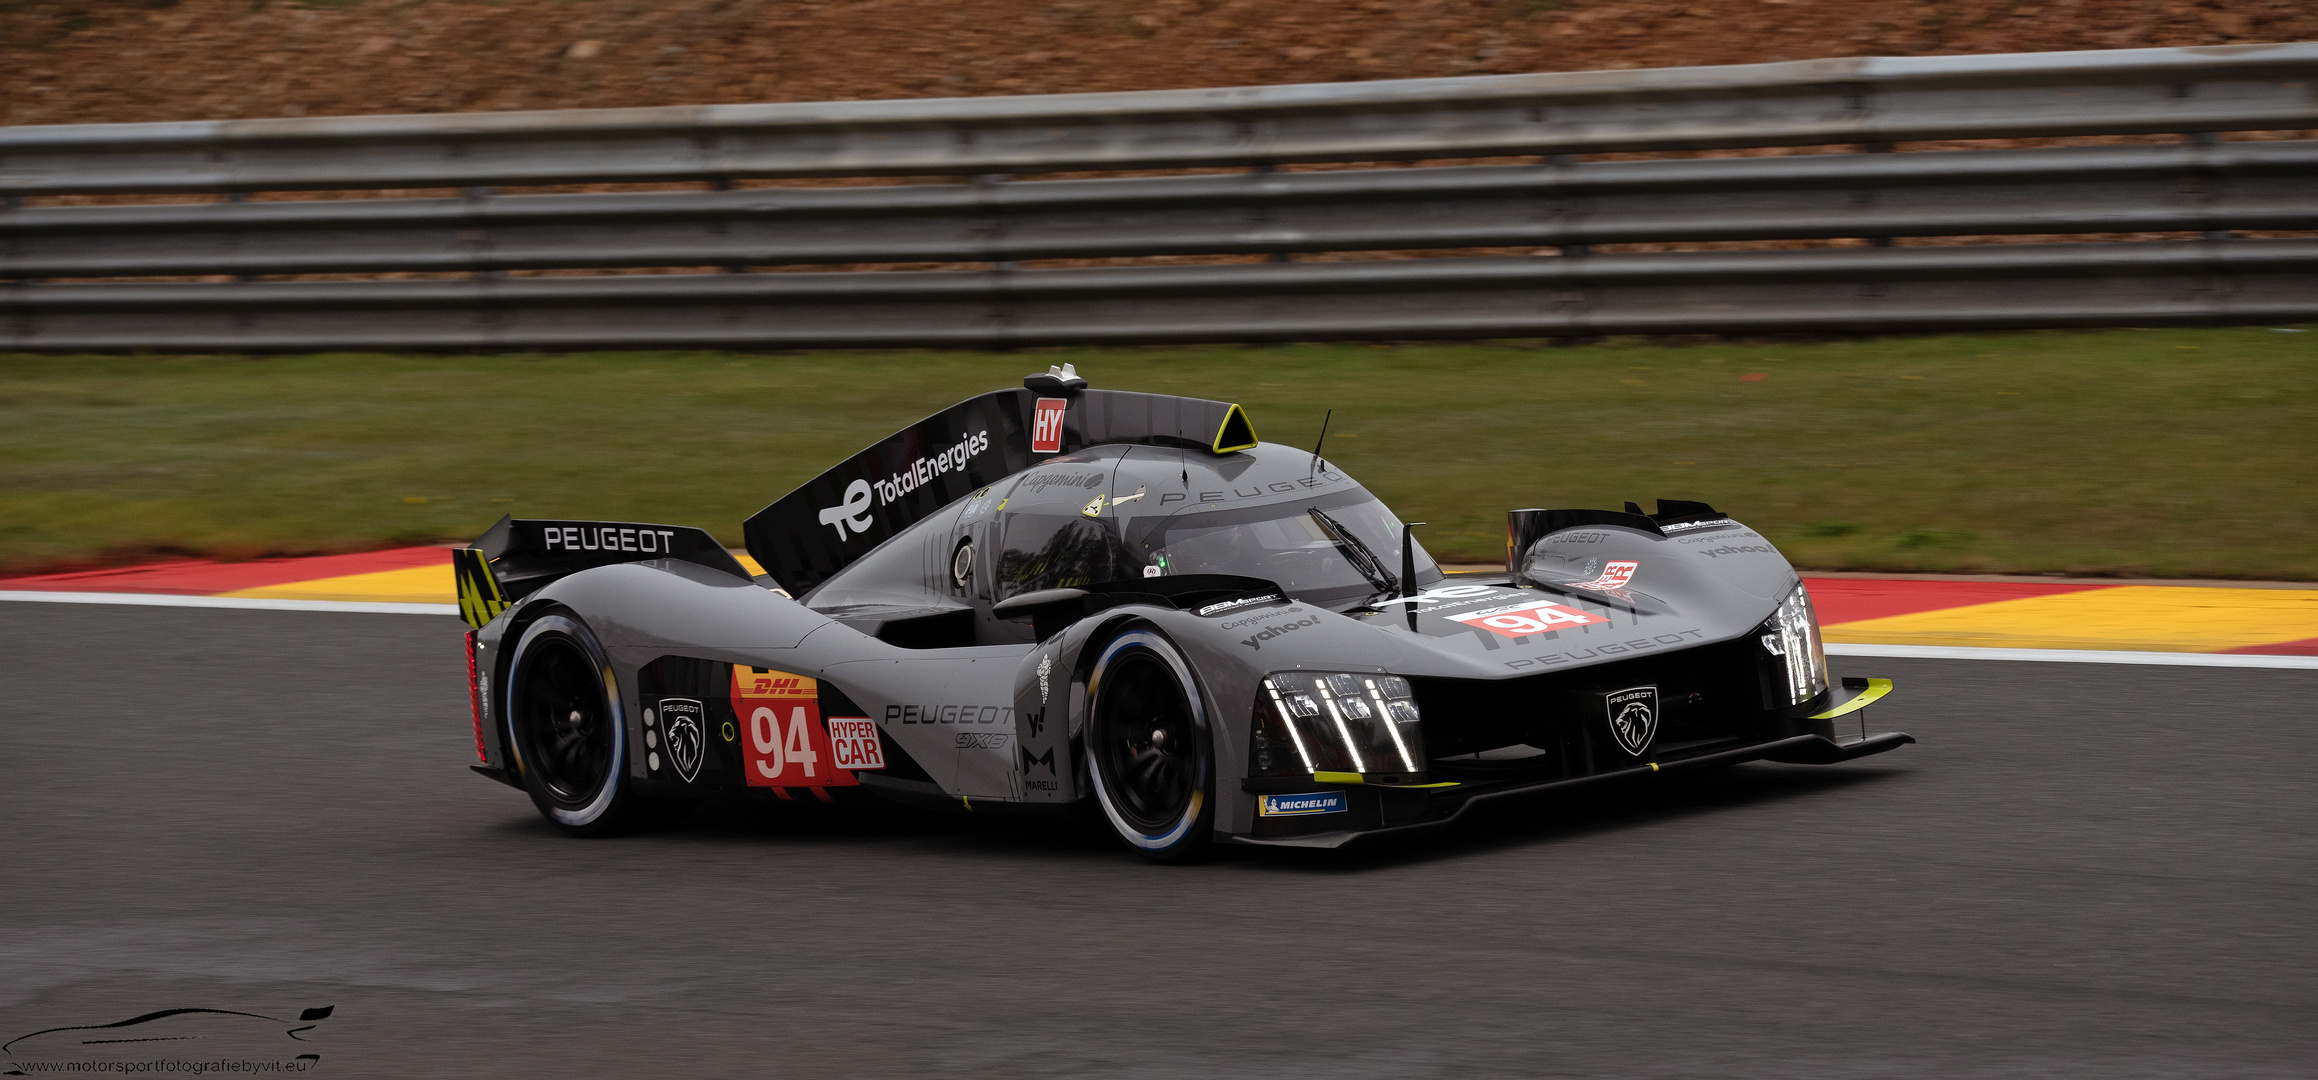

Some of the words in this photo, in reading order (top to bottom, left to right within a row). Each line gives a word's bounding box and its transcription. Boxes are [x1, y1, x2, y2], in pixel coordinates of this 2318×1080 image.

[1035, 409, 1063, 442] HY
[873, 430, 988, 506] TotalEnergies
[1022, 471, 1090, 494] Capgemini
[544, 527, 675, 554] PEUGEOT
[1678, 531, 1744, 545] Capgemini
[1698, 544, 1777, 559] yahoo!
[1221, 609, 1289, 630] Capgemini
[1482, 607, 1592, 633] 94
[1241, 615, 1321, 652] yahoo!
[1503, 629, 1704, 670] PEUGEOT
[752, 678, 804, 695] DHL
[1610, 691, 1653, 705] PEUGEOT
[662, 704, 700, 714] PEUGEOT
[885, 704, 1015, 725] PEUGEOT
[831, 721, 875, 739] HYPER
[750, 706, 818, 779] 94
[834, 738, 882, 766] CAR
[1025, 780, 1058, 792] MARELLI
[1280, 798, 1338, 810] MICHELIN
